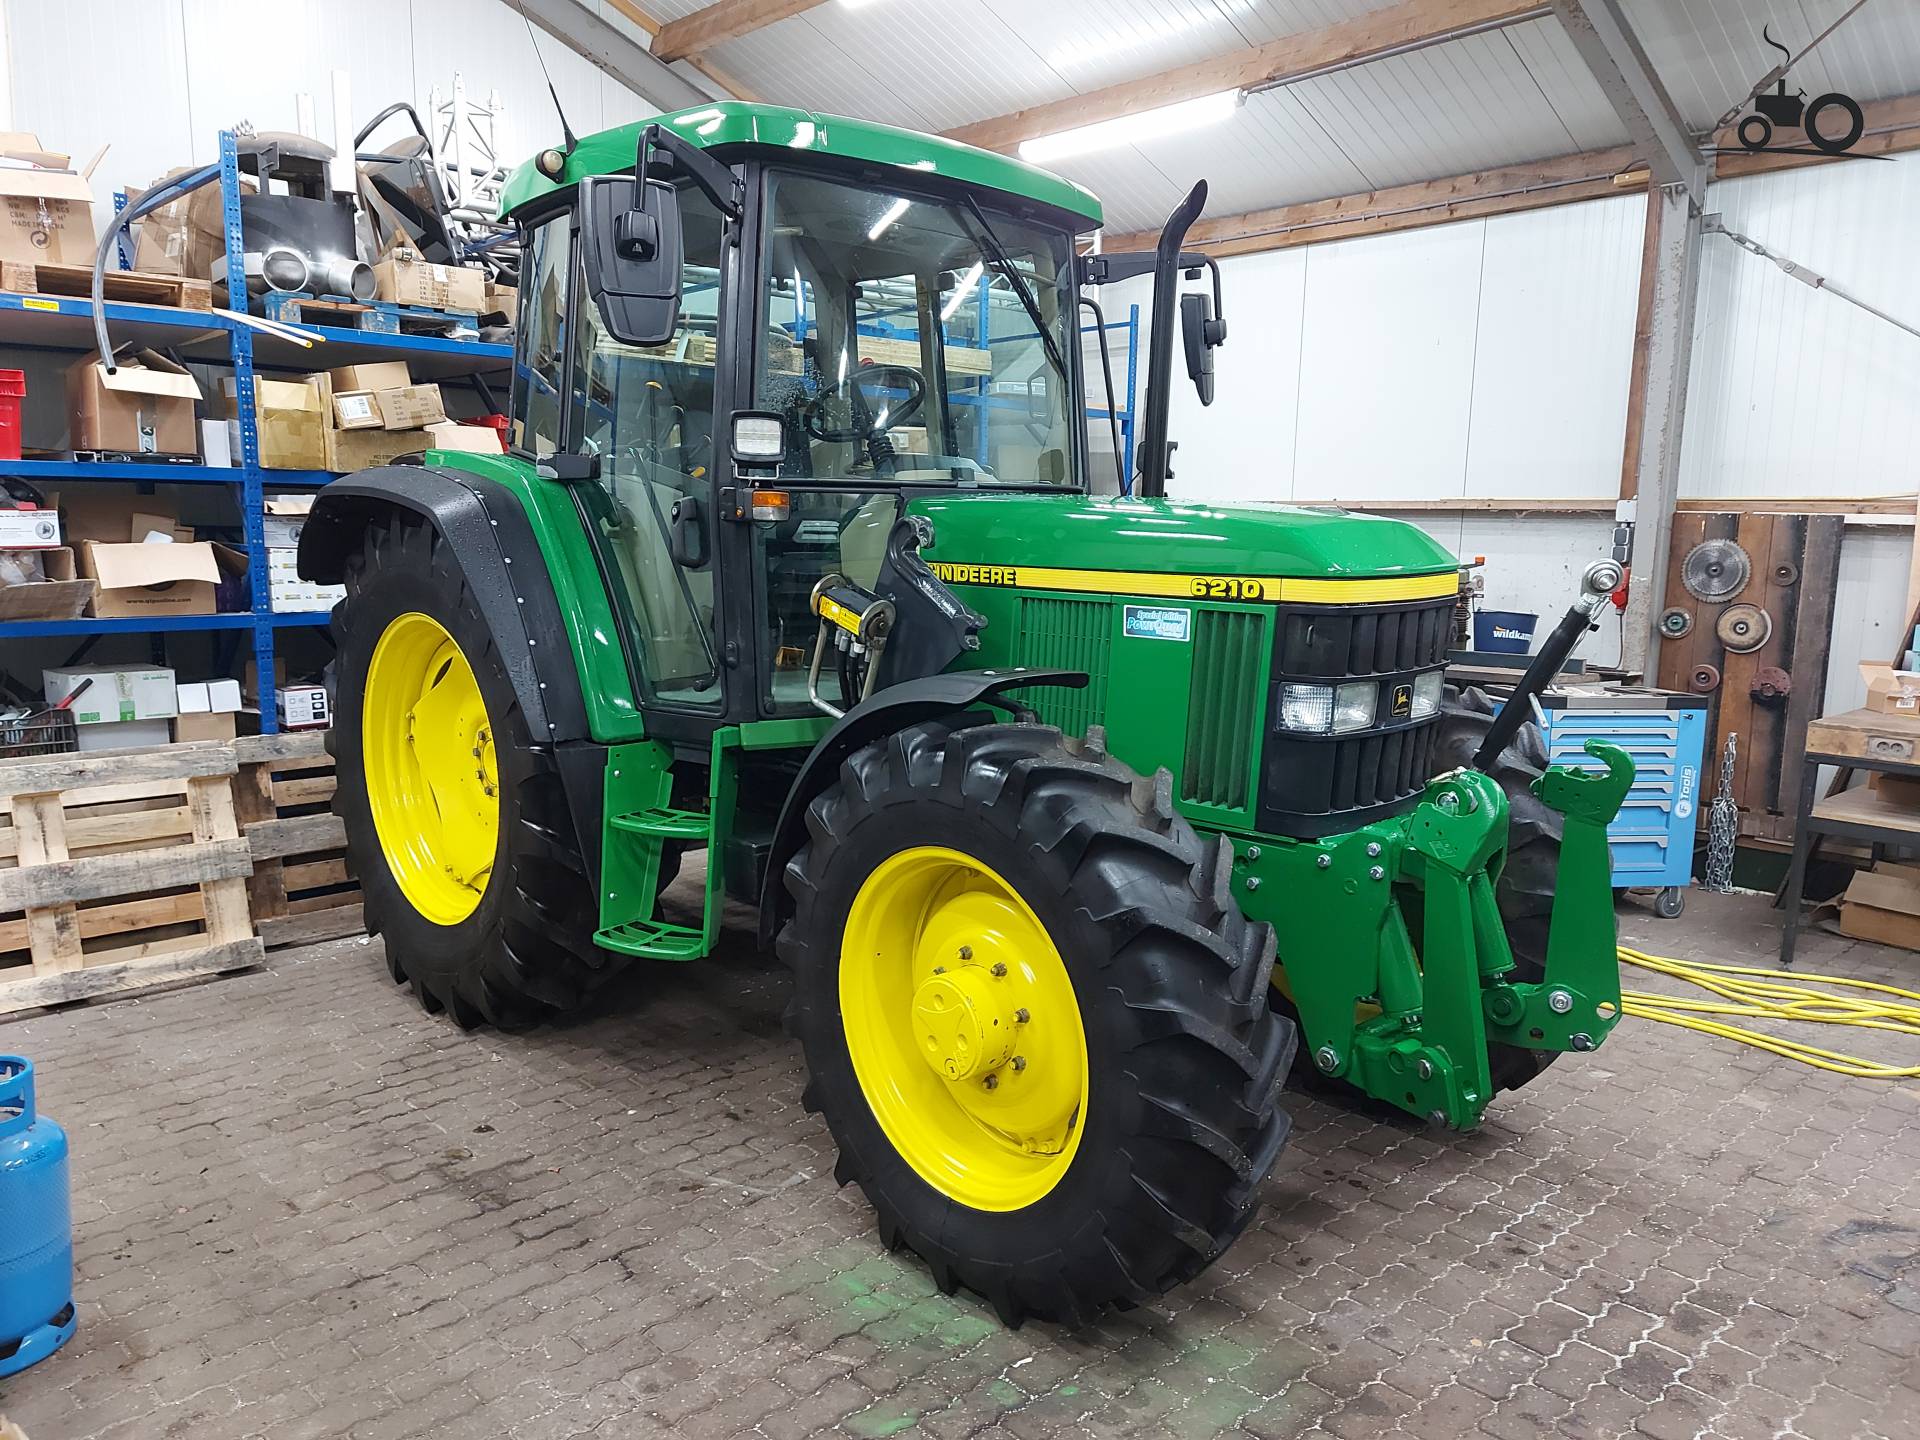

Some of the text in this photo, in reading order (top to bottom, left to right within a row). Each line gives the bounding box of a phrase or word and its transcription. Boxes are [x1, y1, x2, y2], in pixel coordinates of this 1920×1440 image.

[957, 565, 1016, 586] DEERE
[1191, 577, 1263, 600] 6210
[1680, 768, 1692, 799] Tools
